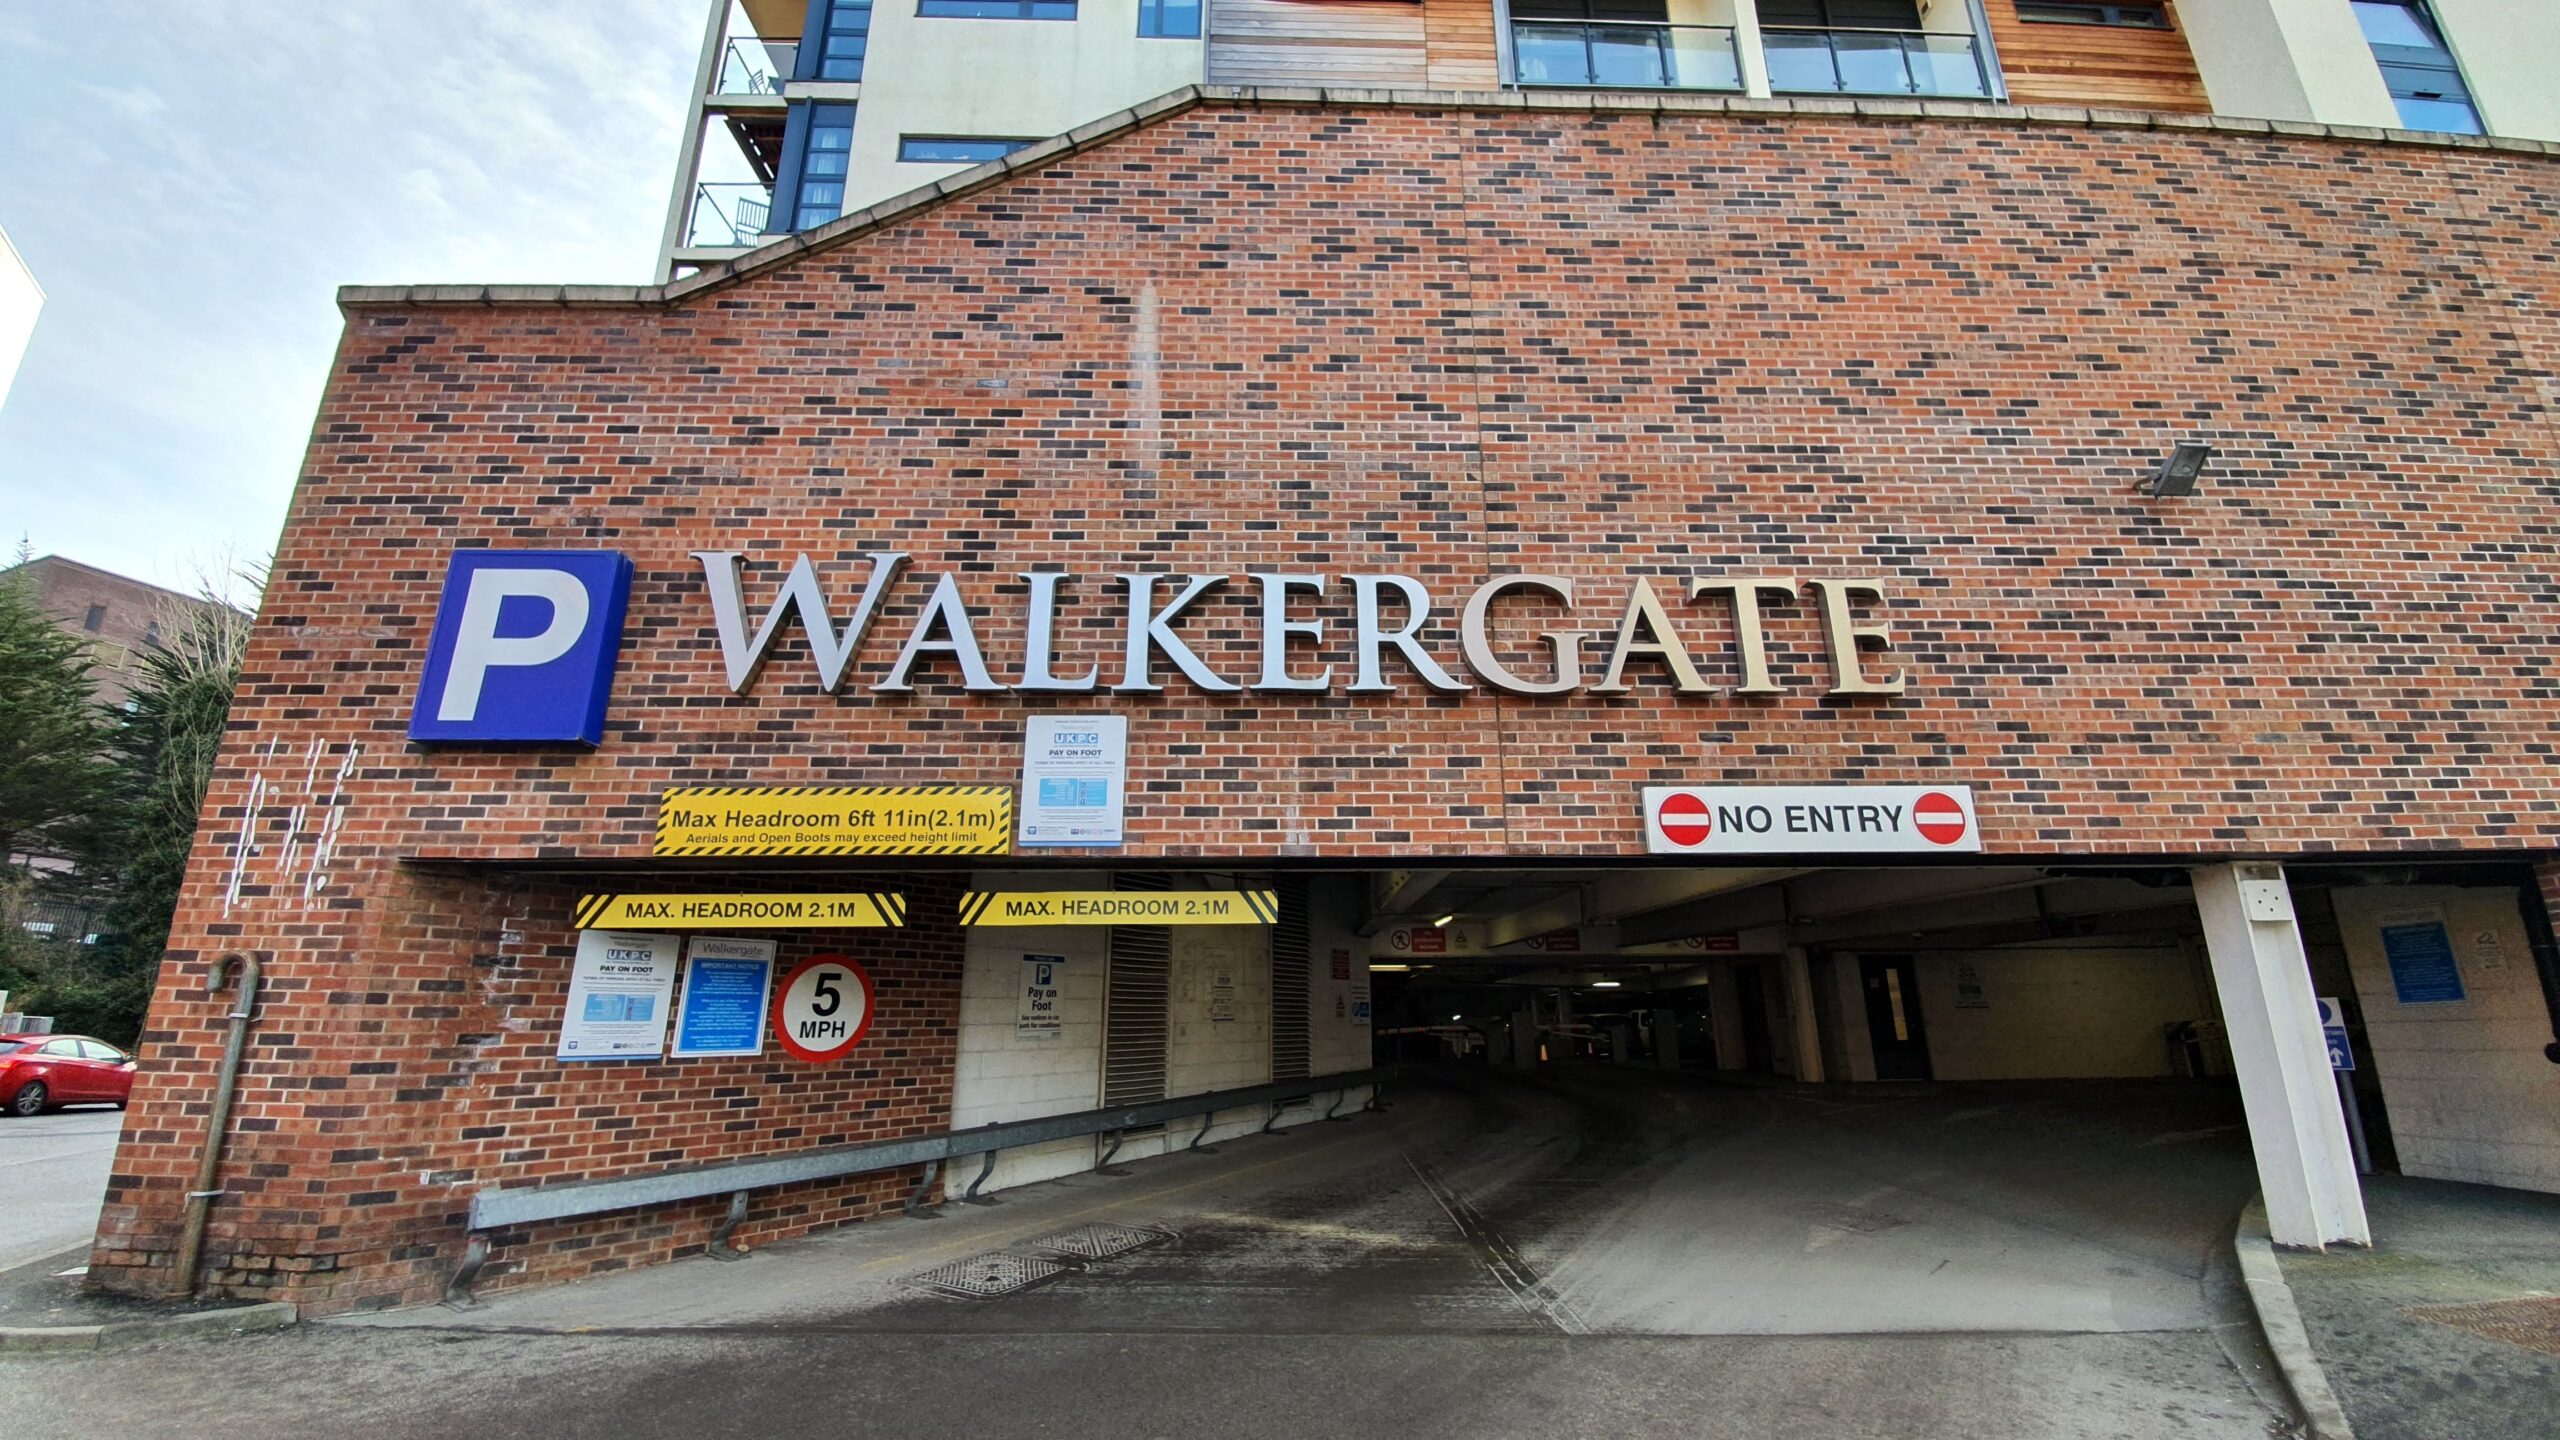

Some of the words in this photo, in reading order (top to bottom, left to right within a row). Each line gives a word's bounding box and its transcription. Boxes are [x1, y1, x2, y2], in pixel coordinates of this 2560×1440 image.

[690, 550, 1906, 696] WALKERGATE
[437, 568, 589, 721] P
[1055, 733, 1098, 743] UKPC
[671, 809, 717, 828] Max
[724, 809, 841, 828] Headroom
[848, 809, 876, 828] 6ft
[883, 809, 996, 831] 11in(2.1m)
[1718, 805, 1773, 833] NO
[1784, 805, 1903, 833] ENTRY
[686, 832, 729, 844] Aerials
[731, 832, 756, 844] and
[758, 832, 793, 846] Open
[795, 832, 831, 843] Boots
[834, 834, 860, 845] may
[863, 832, 907, 843] exceed
[910, 831, 948, 845] height
[951, 831, 978, 843] limit
[625, 902, 675, 919] MAX.
[682, 902, 803, 918] HEADROOM
[808, 902, 856, 918] 2.1M
[1005, 900, 1055, 917] MAX.
[1062, 900, 1180, 916] HEADROOM
[1185, 899, 1230, 915] 2.1M
[607, 949, 652, 961] UKPC
[703, 943, 764, 956] Walkergate
[617, 965, 630, 973] ON
[632, 966, 654, 974] FOOT
[1038, 965, 1050, 984] P
[811, 972, 842, 1017] 5
[1028, 987, 1044, 1000] Pay
[1046, 989, 1057, 998] on
[1032, 1000, 1052, 1011] Foot
[799, 1020, 846, 1039] MPH
